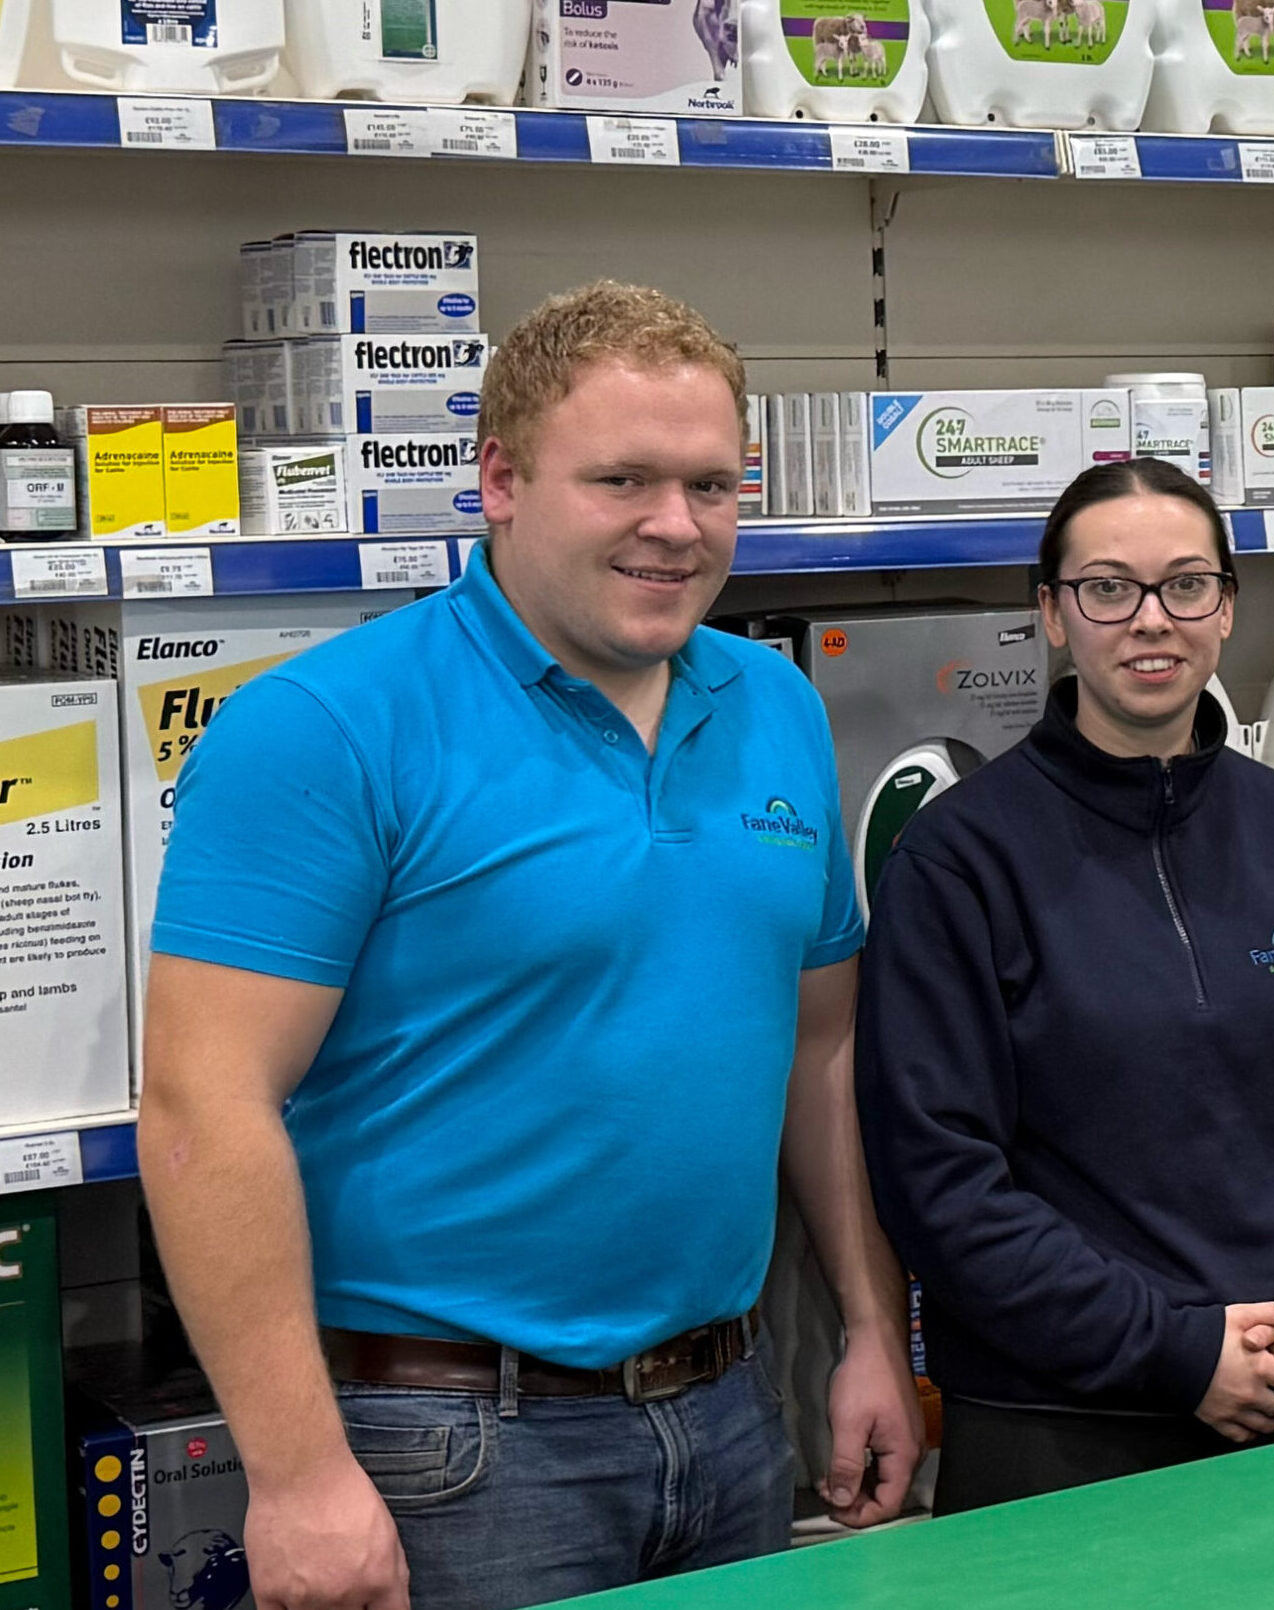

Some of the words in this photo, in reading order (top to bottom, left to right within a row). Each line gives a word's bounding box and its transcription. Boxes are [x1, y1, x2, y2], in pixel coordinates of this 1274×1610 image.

[562, 1, 603, 17] Bolus
[564, 28, 573, 37] To
[574, 29, 602, 38] reduce
[603, 30, 617, 39] the
[588, 41, 619, 50] ketosis
[687, 98, 735, 109] Norbrook
[349, 240, 443, 269] flectron
[354, 340, 452, 369] flectron
[94, 450, 160, 461] Adrenacaine
[170, 450, 234, 460] Adrenacaine
[360, 440, 458, 469] flectron
[960, 456, 987, 466] ADULT
[987, 455, 1015, 465] SHEEP
[956, 668, 1037, 690] ZOLVIX
[26, 821, 51, 836] 2.5
[54, 818, 102, 833] Litres
[741, 813, 818, 847] FaneValley
[0, 851, 34, 869] ion
[12, 882, 46, 893] mature
[48, 880, 80, 889] flukes.
[1, 897, 35, 909] (sheep
[65, 892, 81, 902] bot
[26, 909, 59, 920] stages
[60, 907, 70, 916] of
[50, 935, 86, 946] feeding
[88, 934, 101, 942] on
[9, 954, 25, 963] are
[54, 951, 65, 960] to
[67, 947, 107, 959] produce
[11, 986, 35, 999] and
[38, 981, 78, 995] lambs
[0, 1003, 28, 1014] santel
[153, 1465, 187, 1485] Oral
[191, 1456, 245, 1479] Soluti
[130, 1446, 148, 1556] CYDECTIN
